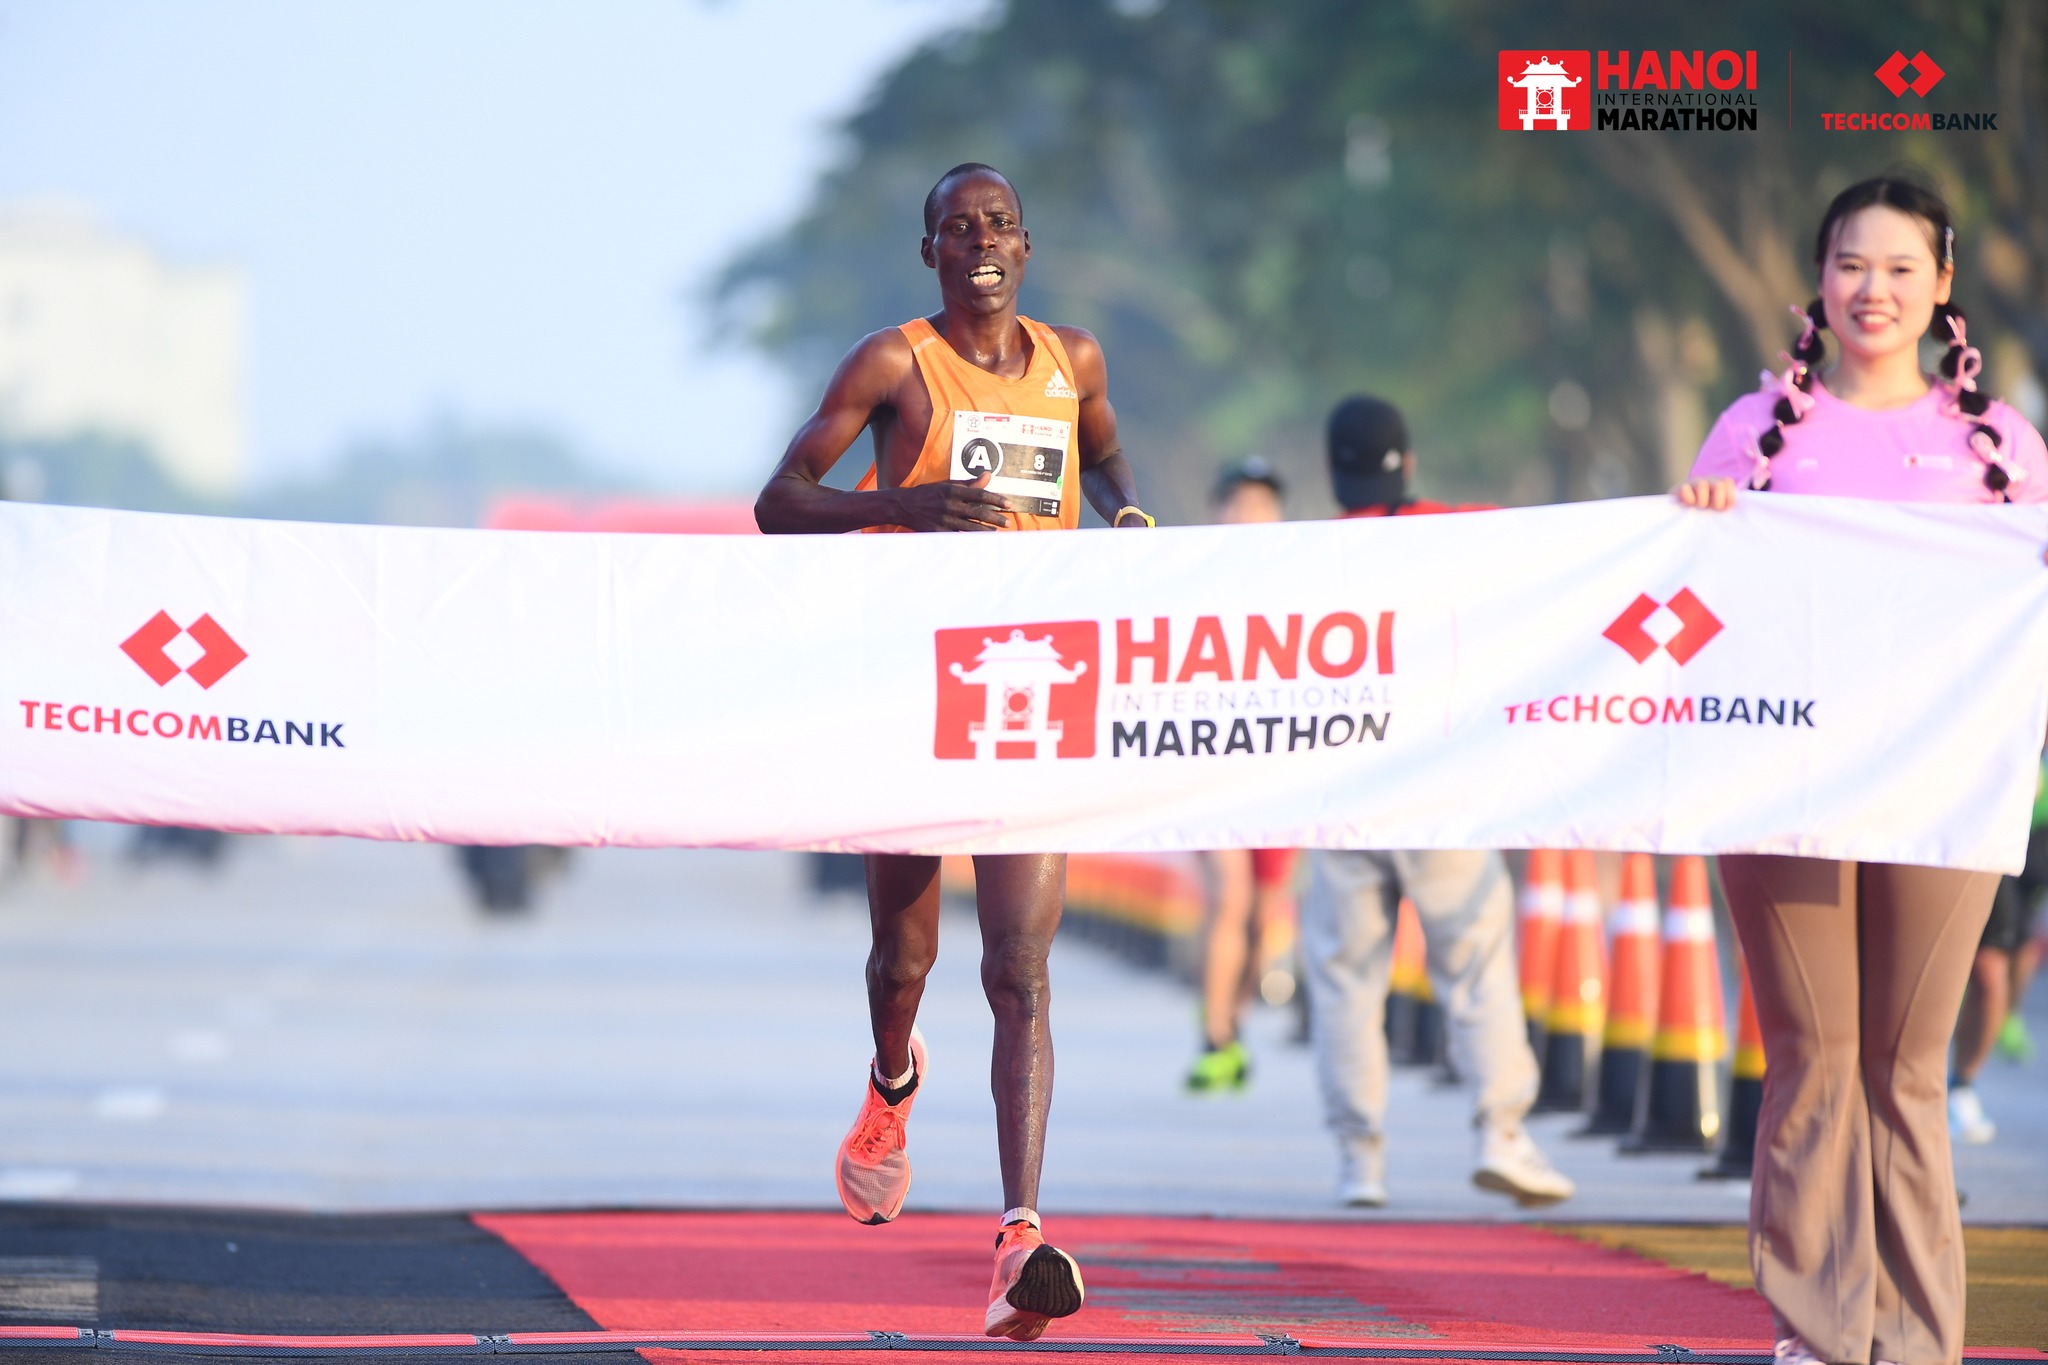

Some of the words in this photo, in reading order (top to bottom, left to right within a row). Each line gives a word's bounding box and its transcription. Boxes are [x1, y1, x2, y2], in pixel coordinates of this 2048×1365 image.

[968, 445, 991, 470] A
[1034, 454, 1045, 470] 8
[1115, 610, 1396, 685] HANOI
[1111, 684, 1395, 712] INTERNATIONAL
[1504, 694, 1818, 729] TECHCOMBANK
[19, 699, 347, 749] TECHCOMBANK
[1111, 712, 1392, 758] MARATHON
